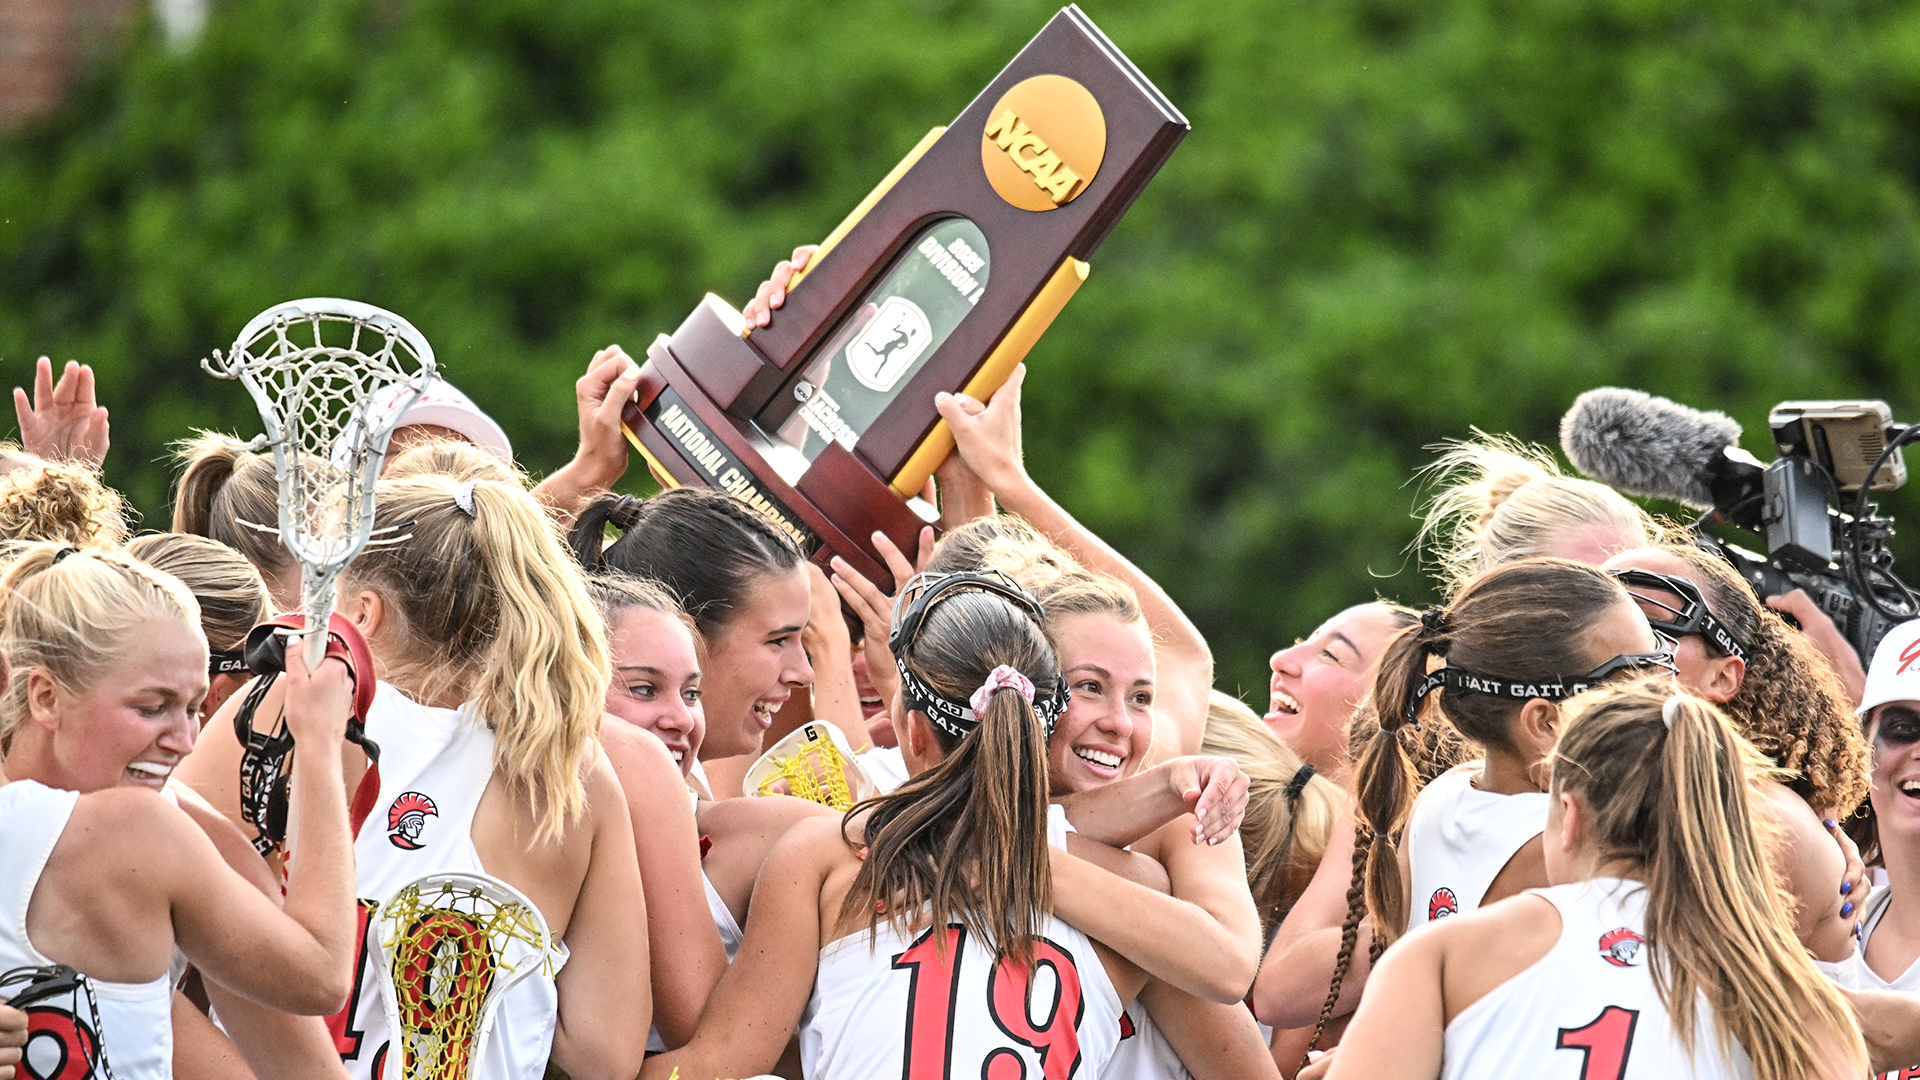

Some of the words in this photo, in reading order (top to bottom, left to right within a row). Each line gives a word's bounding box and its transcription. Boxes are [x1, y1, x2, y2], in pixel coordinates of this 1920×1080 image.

[984, 109, 1083, 207] NCAA
[918, 236, 979, 296] DIVISION
[947, 237, 985, 274] 2025
[660, 404, 728, 477] NATIONAL
[1716, 628, 1744, 657] GAIT
[219, 660, 250, 672] GA
[1510, 683, 1563, 698] GAIT
[927, 705, 971, 740] GAIT
[891, 923, 1085, 1080] 19
